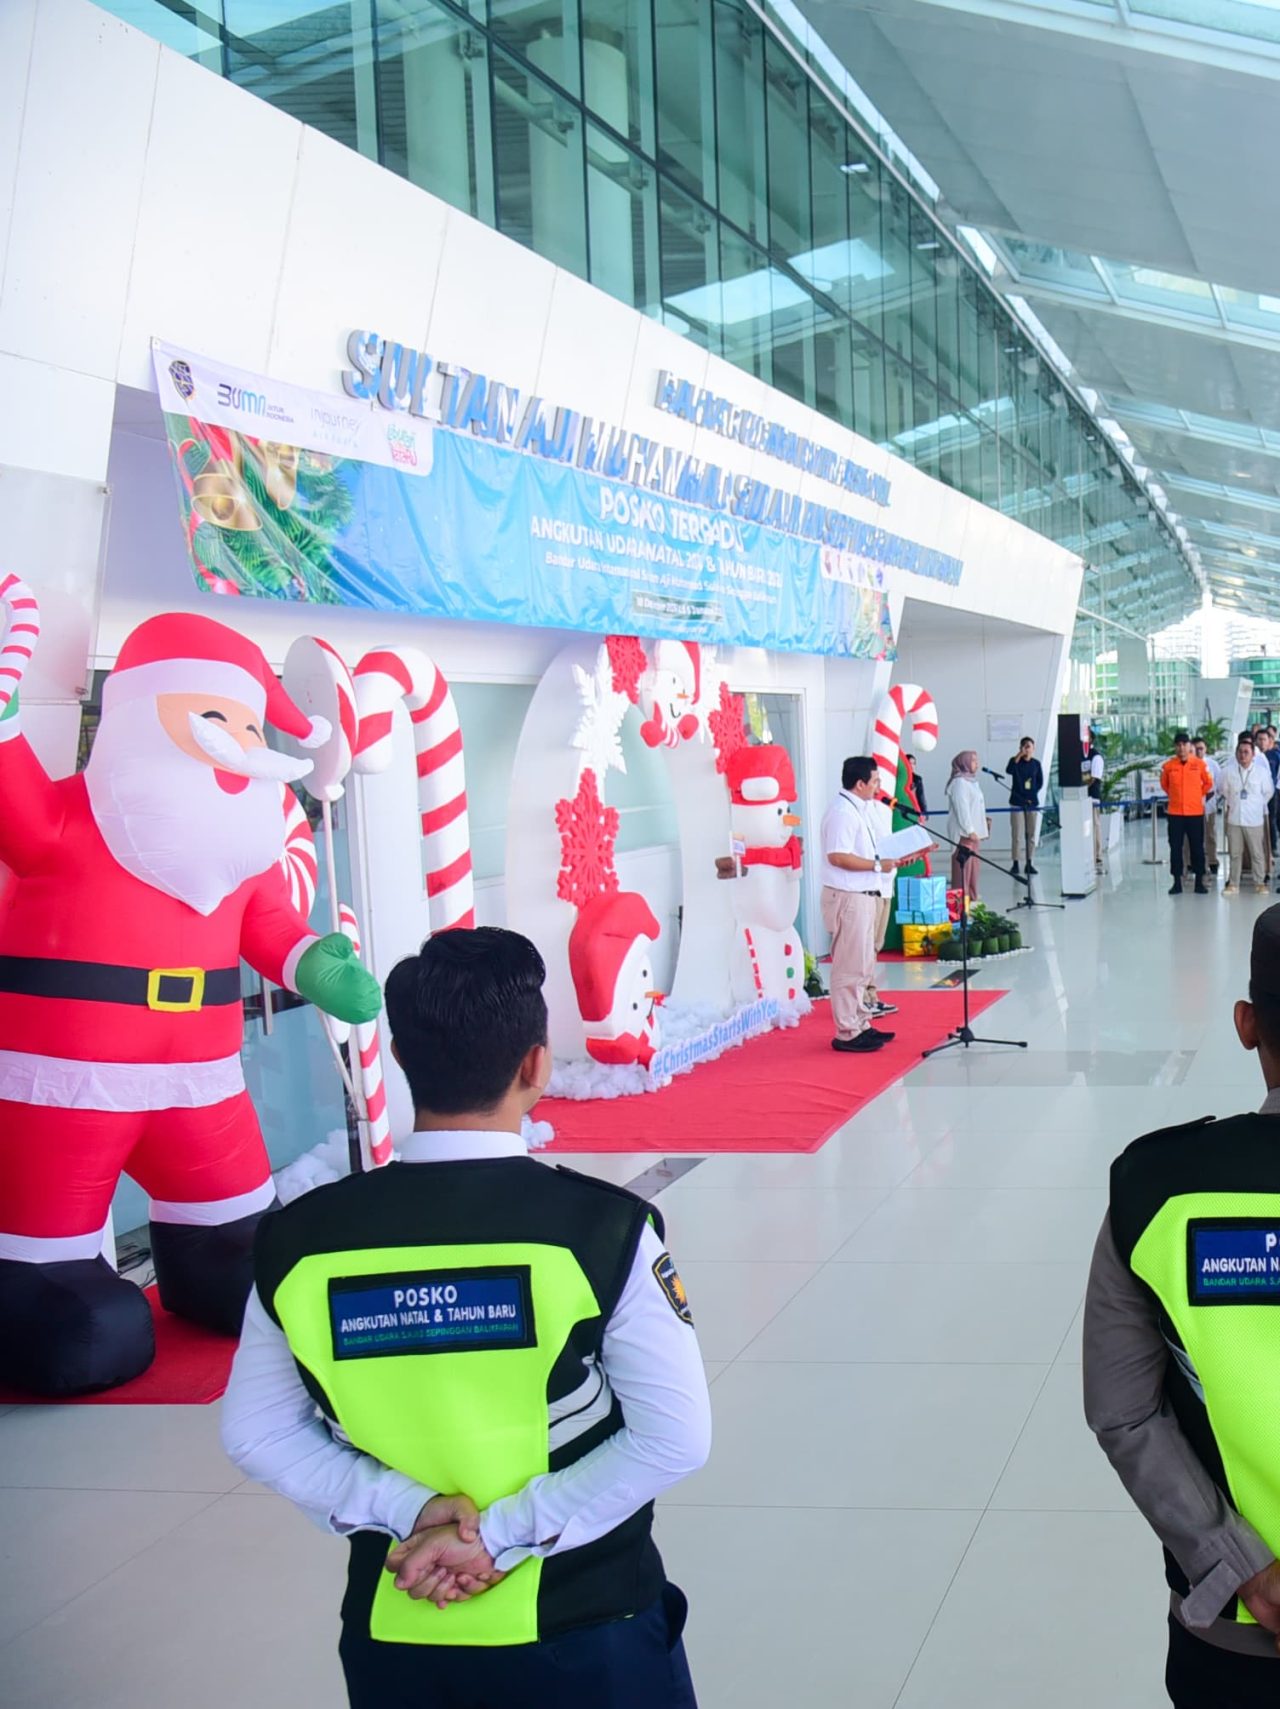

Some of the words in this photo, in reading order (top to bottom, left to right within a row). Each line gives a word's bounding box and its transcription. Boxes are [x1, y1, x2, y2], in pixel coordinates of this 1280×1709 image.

[341, 328, 521, 444] SULTAN
[513, 395, 580, 464] AJI
[600, 485, 666, 535] POSKO
[669, 507, 745, 554] TERPADU
[531, 515, 604, 552] ANGKUTAN
[706, 555, 716, 573] &
[653, 999, 778, 1075] #ChristmasStartsWithYou
[1202, 1257, 1267, 1273] ANGKUTAN
[1203, 1277, 1237, 1287] BANDAR
[1239, 1277, 1267, 1286] UDARA
[393, 1284, 458, 1308] POSKO
[341, 1313, 398, 1333] ANGKUTAN
[400, 1310, 430, 1325] NATAL
[434, 1309, 443, 1323] &
[447, 1305, 485, 1321] TAHUN
[488, 1304, 516, 1319] BARU
